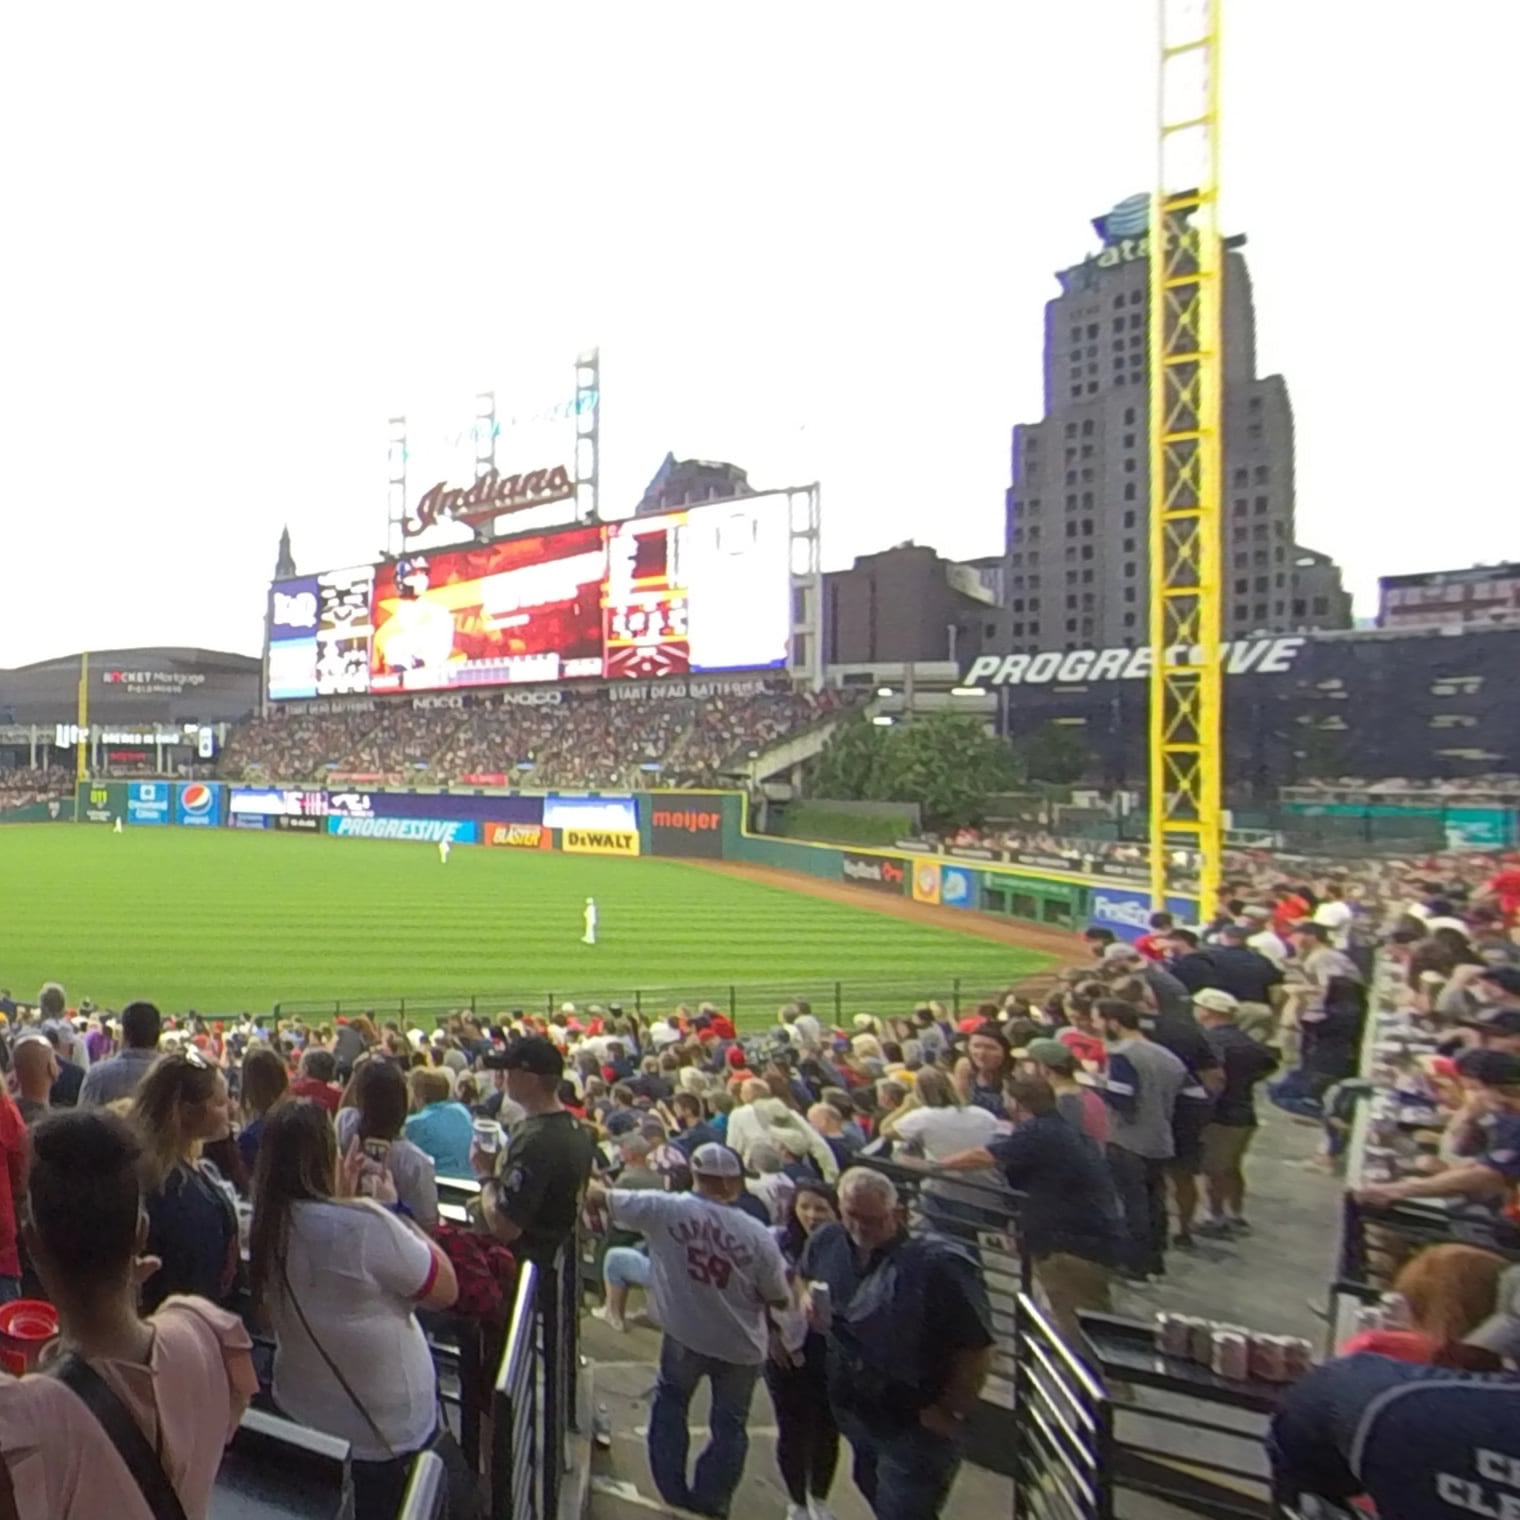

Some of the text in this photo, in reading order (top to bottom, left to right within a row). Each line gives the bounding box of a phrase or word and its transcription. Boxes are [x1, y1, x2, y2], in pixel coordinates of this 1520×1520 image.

[402, 465, 576, 537] Indians
[963, 638, 1306, 687] PROGREIVE
[103, 670, 205, 685] ROCKET Mortgage
[412, 696, 463, 710] NOCO
[503, 691, 563, 705] NOCO
[609, 684, 647, 700] START
[650, 684, 686, 699] DEAD
[337, 816, 461, 842] PROGRESSIVE
[652, 810, 721, 833] meijer
[687, 1246, 734, 1290] 59
